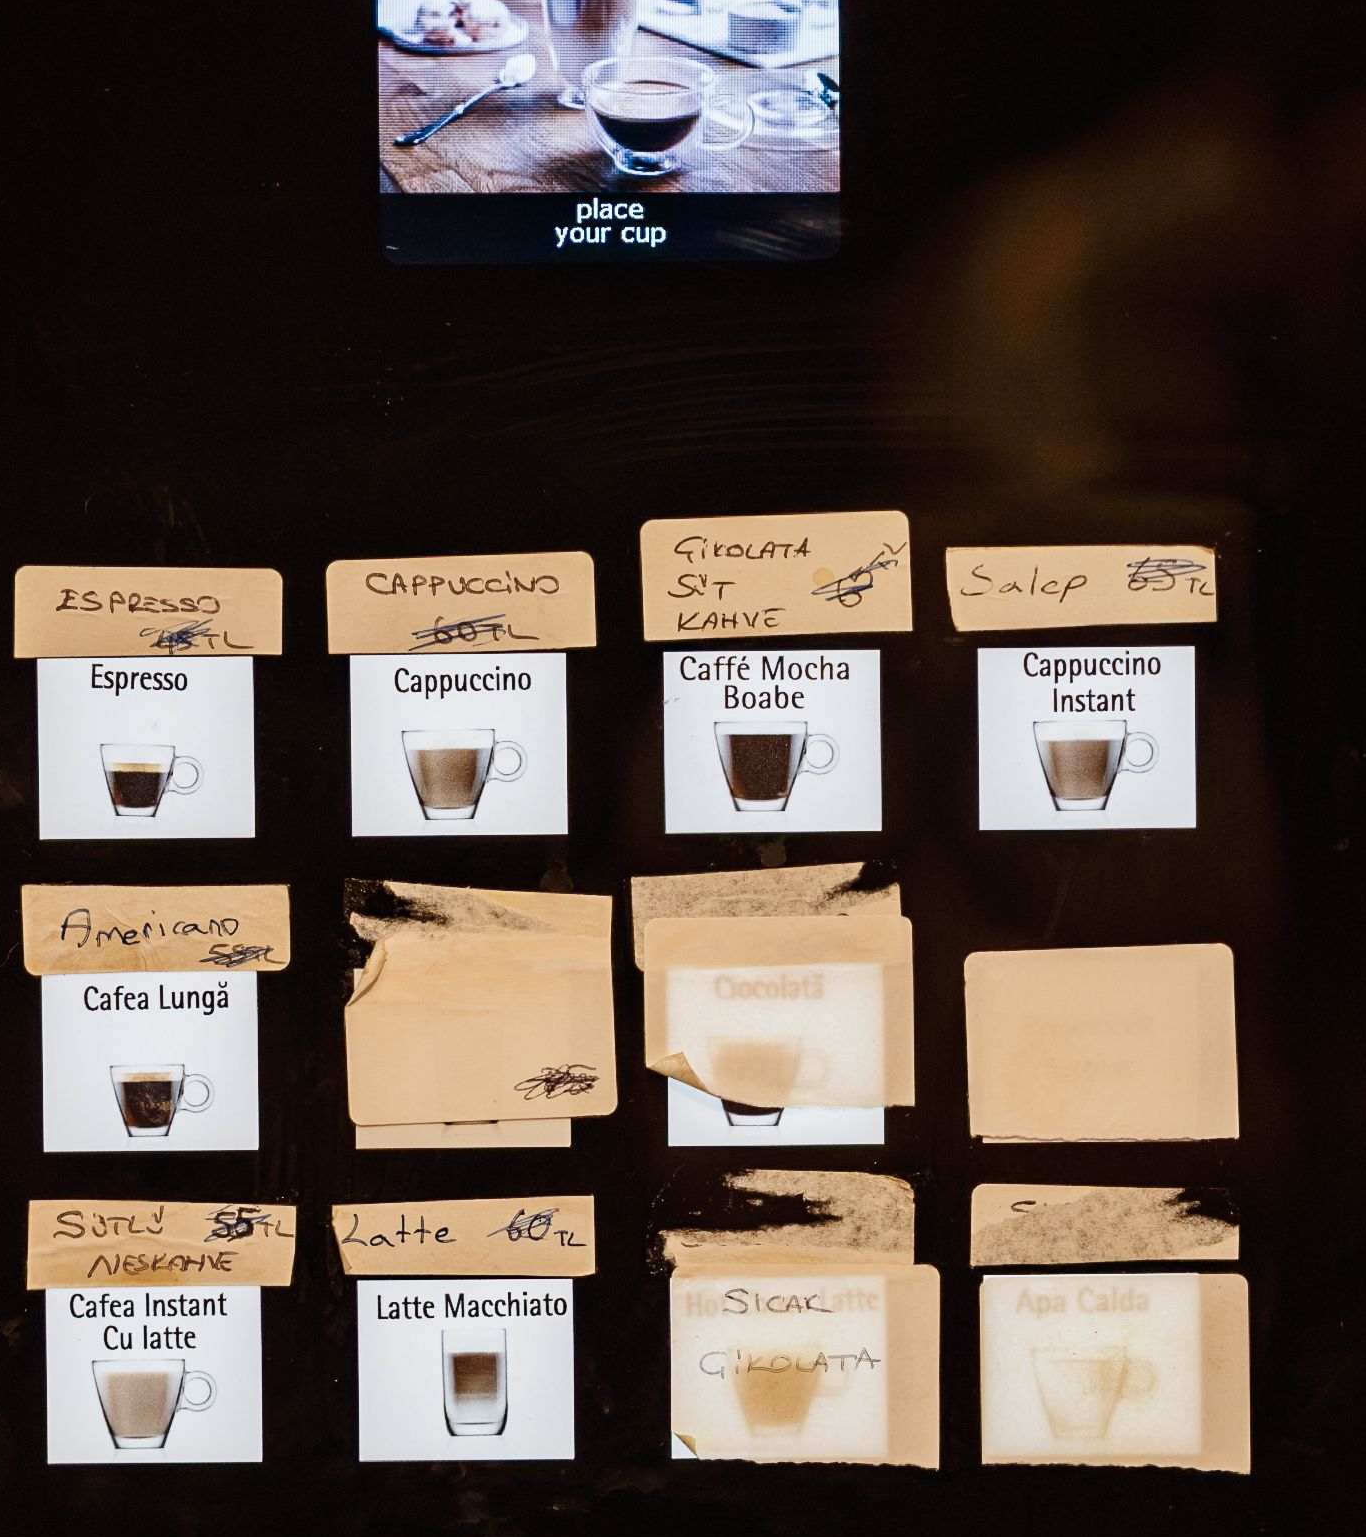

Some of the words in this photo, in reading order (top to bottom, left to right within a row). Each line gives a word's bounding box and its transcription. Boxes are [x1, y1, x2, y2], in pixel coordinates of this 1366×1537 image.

[576, 197, 645, 224] place
[554, 226, 612, 248] your
[620, 226, 667, 248] cup
[959, 563, 1089, 604] Salep
[55, 588, 221, 615] ESPRESSO
[676, 607, 787, 633] KAHVE
[90, 663, 189, 697] Espresso
[679, 655, 751, 682] Caffé
[761, 654, 851, 682] Mocha
[1022, 650, 1162, 684] Cappuccino
[394, 665, 532, 700] Cappuccino
[723, 684, 806, 710] Boabe
[1053, 687, 1137, 713] Instant
[60, 907, 240, 949] Americano
[83, 984, 150, 1012] Cafea
[159, 980, 230, 1016] Lungă
[341, 1213, 457, 1248] Latte
[87, 1250, 239, 1279] NESKAHVE
[69, 1292, 135, 1319] Cafea
[145, 1292, 229, 1318] Instant
[377, 1294, 435, 1320] Latte
[444, 1291, 568, 1319] Macchiato
[722, 1287, 835, 1315] SICAK
[103, 1325, 133, 1351] Cu
[143, 1324, 197, 1350] latte
